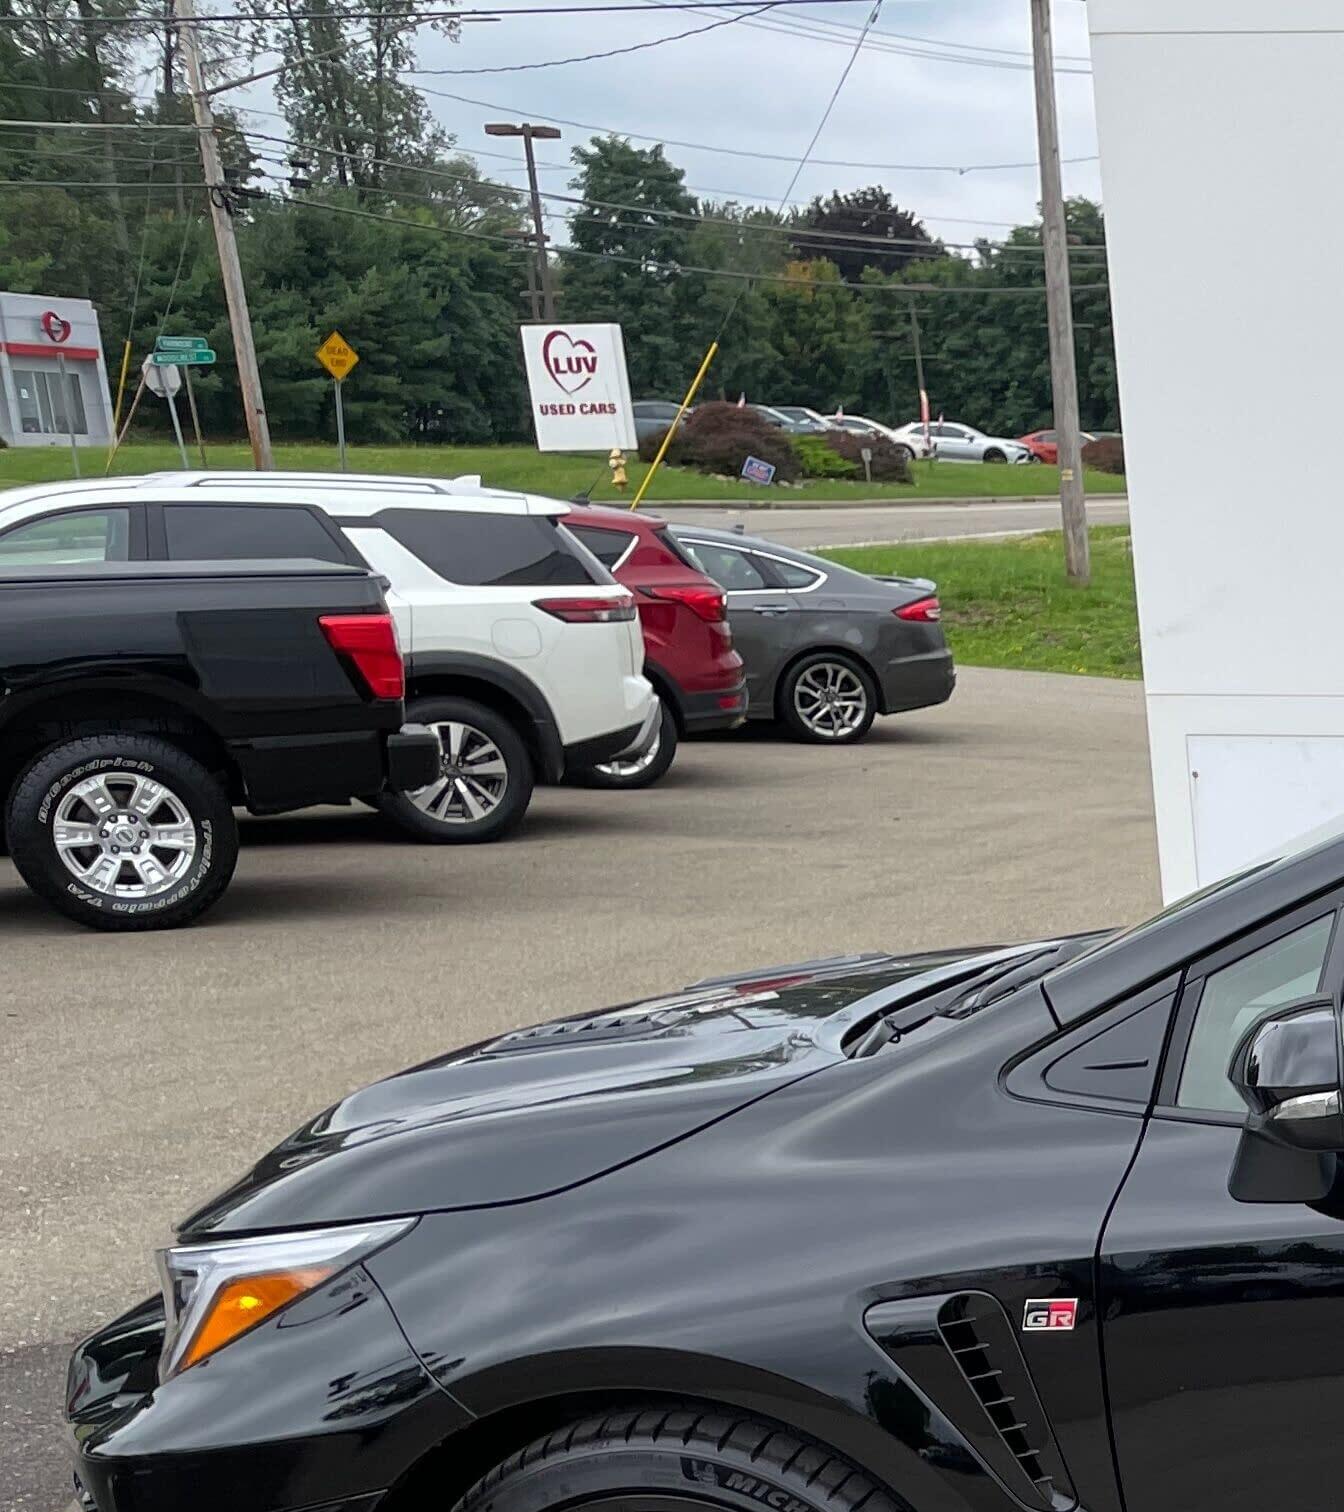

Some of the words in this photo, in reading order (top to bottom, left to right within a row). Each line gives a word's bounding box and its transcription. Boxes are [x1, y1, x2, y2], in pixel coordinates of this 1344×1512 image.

[553, 356, 598, 374] LUV
[539, 404, 576, 416] USED
[579, 403, 617, 415] CARS
[1025, 1309, 1074, 1327] GR
